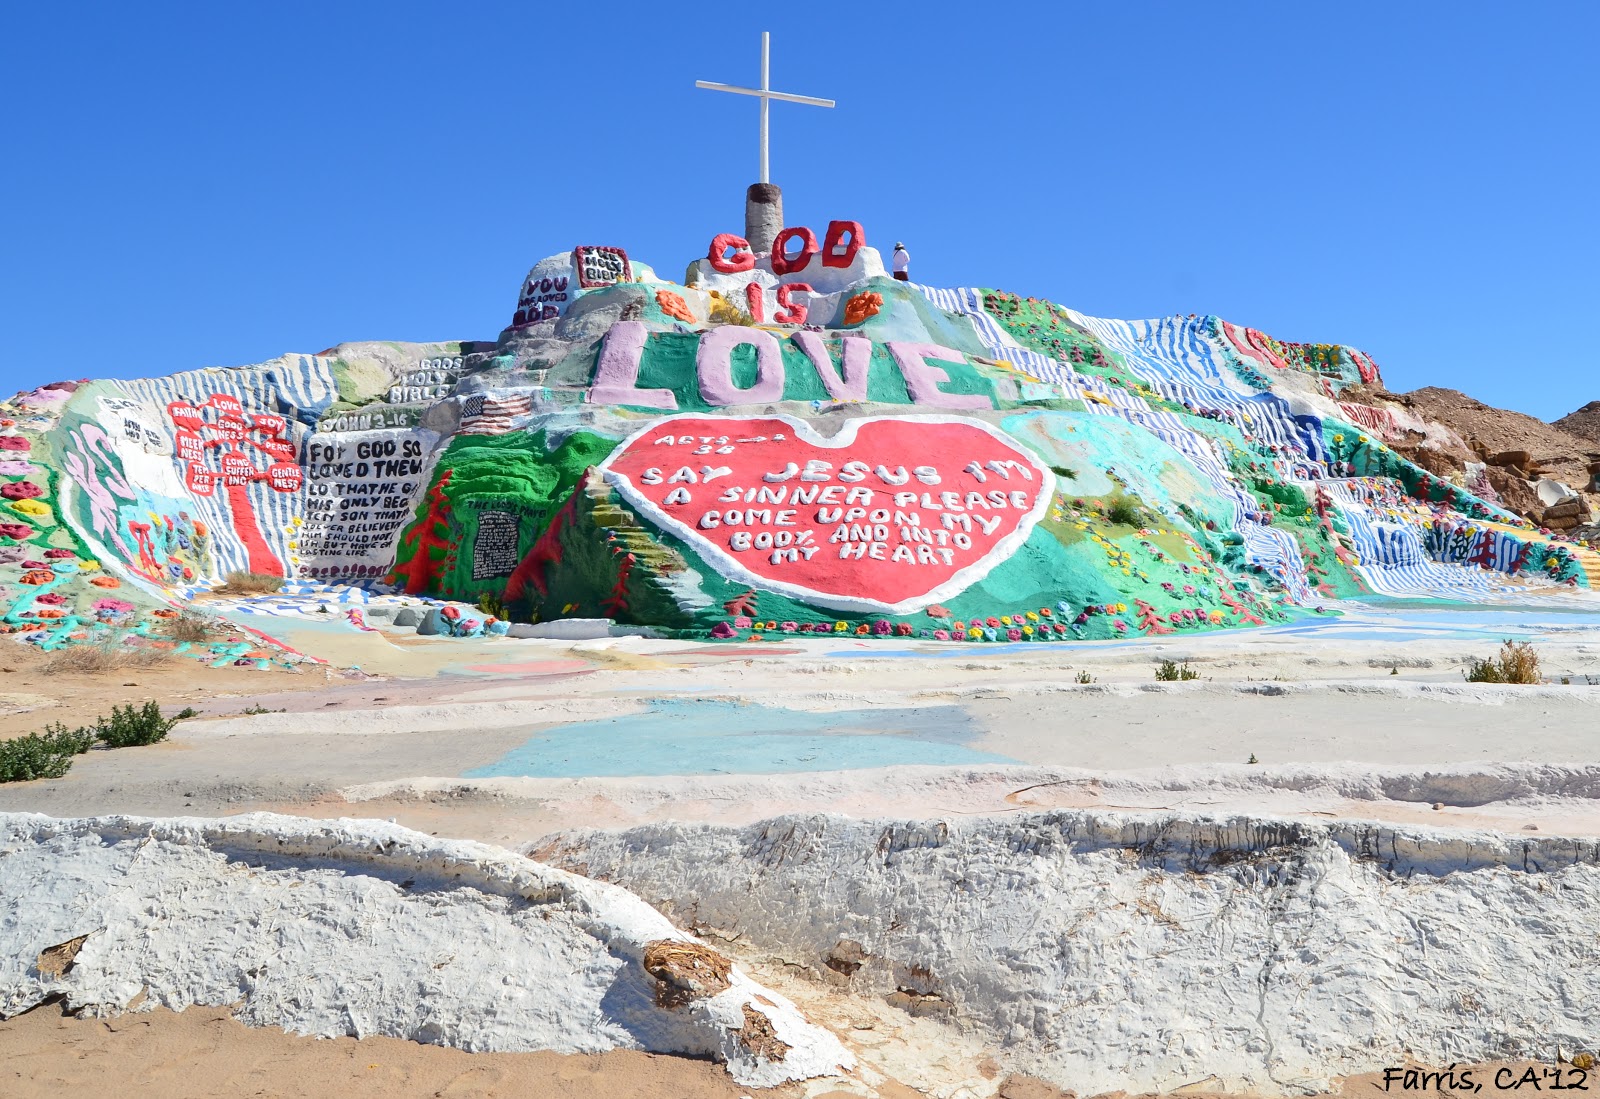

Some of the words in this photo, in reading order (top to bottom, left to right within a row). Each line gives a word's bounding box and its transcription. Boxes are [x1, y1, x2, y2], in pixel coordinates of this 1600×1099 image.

[709, 219, 865, 276] GOD
[586, 267, 624, 280] BIBL
[527, 276, 569, 296] YOU
[746, 281, 813, 324] IS
[585, 321, 992, 410] LOVE
[389, 384, 450, 404] BIBLE
[213, 398, 241, 411] LOVE
[172, 407, 200, 419] FAITH
[218, 419, 243, 431] GOOD
[259, 418, 284, 431] JOY
[321, 414, 373, 432] JOHN
[219, 430, 244, 440] NESS
[653, 435, 730, 446] ACTS
[265, 441, 293, 453] PEACE
[357, 439, 397, 460] GOD
[402, 439, 423, 458] SO
[225, 467, 254, 477] SUFFER
[271, 467, 300, 478] GENTLE
[310, 461, 369, 480] LOVED
[641, 466, 733, 485] SAY
[763, 459, 942, 486] JESUS
[193, 475, 210, 484] PER
[273, 478, 299, 490] NESS
[340, 496, 381, 510] ONLY
[662, 486, 692, 505] A
[718, 484, 875, 506] SINNER
[892, 490, 1029, 512] PLEASE
[340, 511, 369, 521] SON
[698, 508, 797, 531] COME
[817, 507, 920, 528] UPON
[939, 512, 1001, 535] MY
[325, 532, 369, 543] SHOULD
[371, 532, 392, 541] NOT
[828, 523, 889, 545] AND
[899, 525, 972, 550] INTO
[323, 541, 348, 549] BUT
[350, 541, 378, 550] HAVE
[769, 545, 820, 565] MY
[839, 541, 954, 566] HEART
